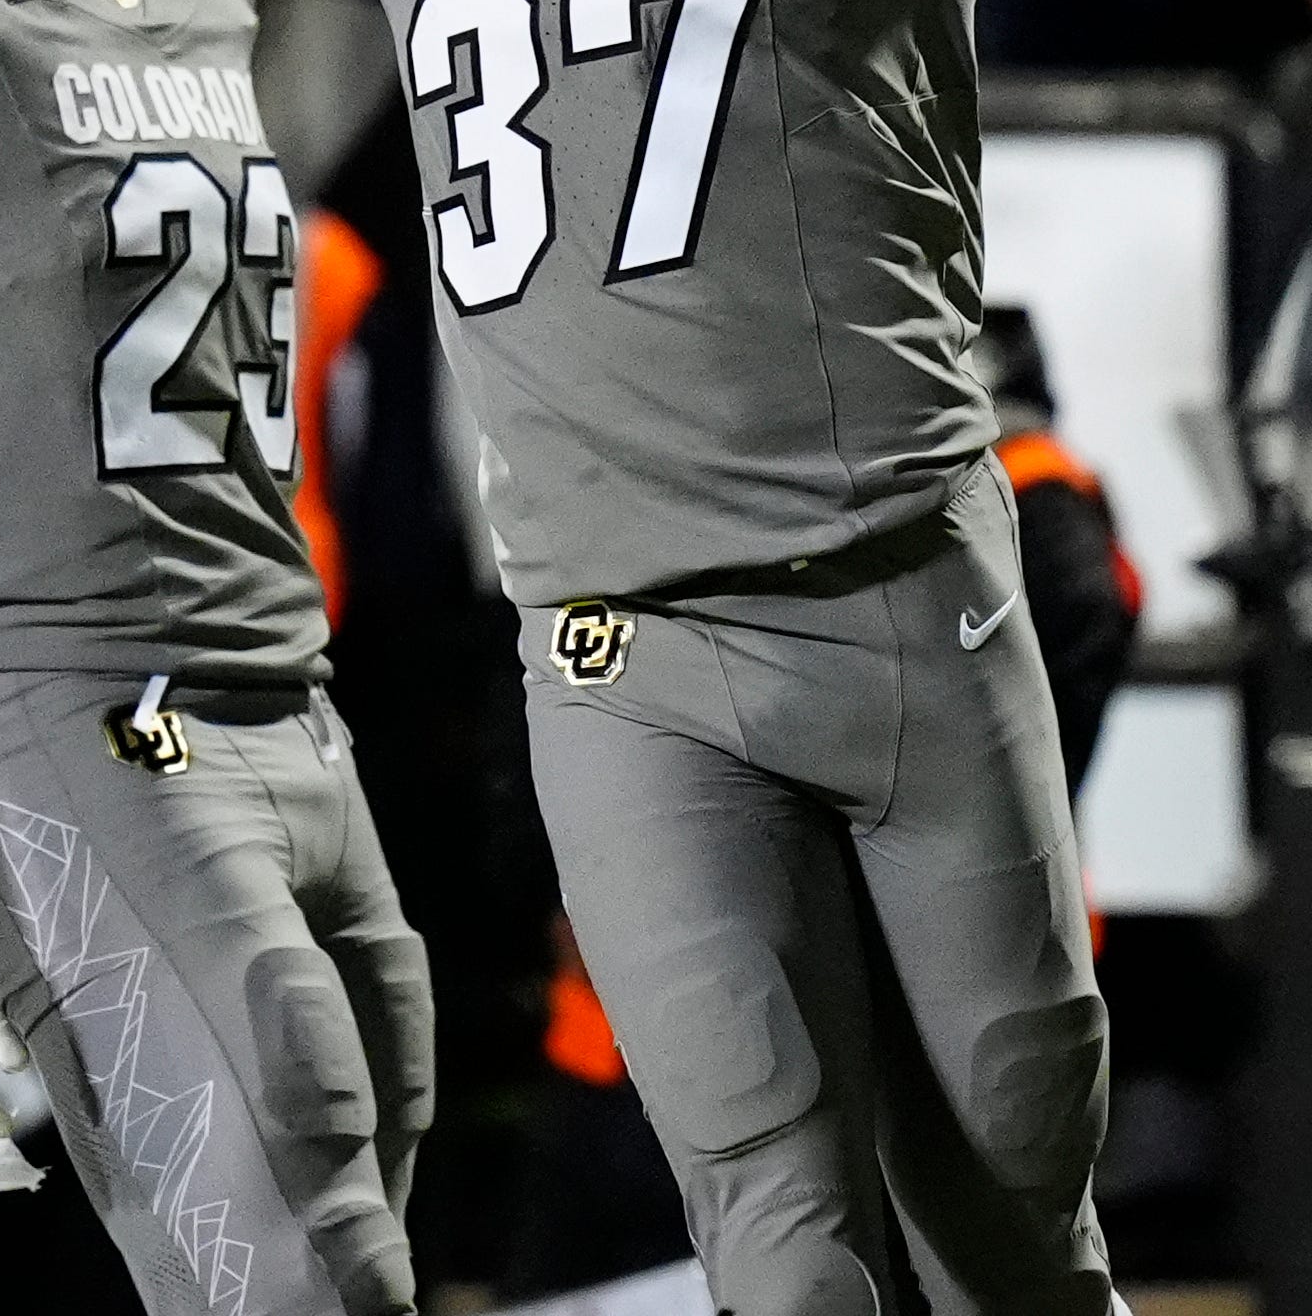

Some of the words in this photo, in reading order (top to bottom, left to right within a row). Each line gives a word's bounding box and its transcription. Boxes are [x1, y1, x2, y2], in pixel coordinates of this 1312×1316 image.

[53, 62, 266, 145] COLORAD
[94, 152, 299, 481] 23
[553, 600, 630, 684] CU
